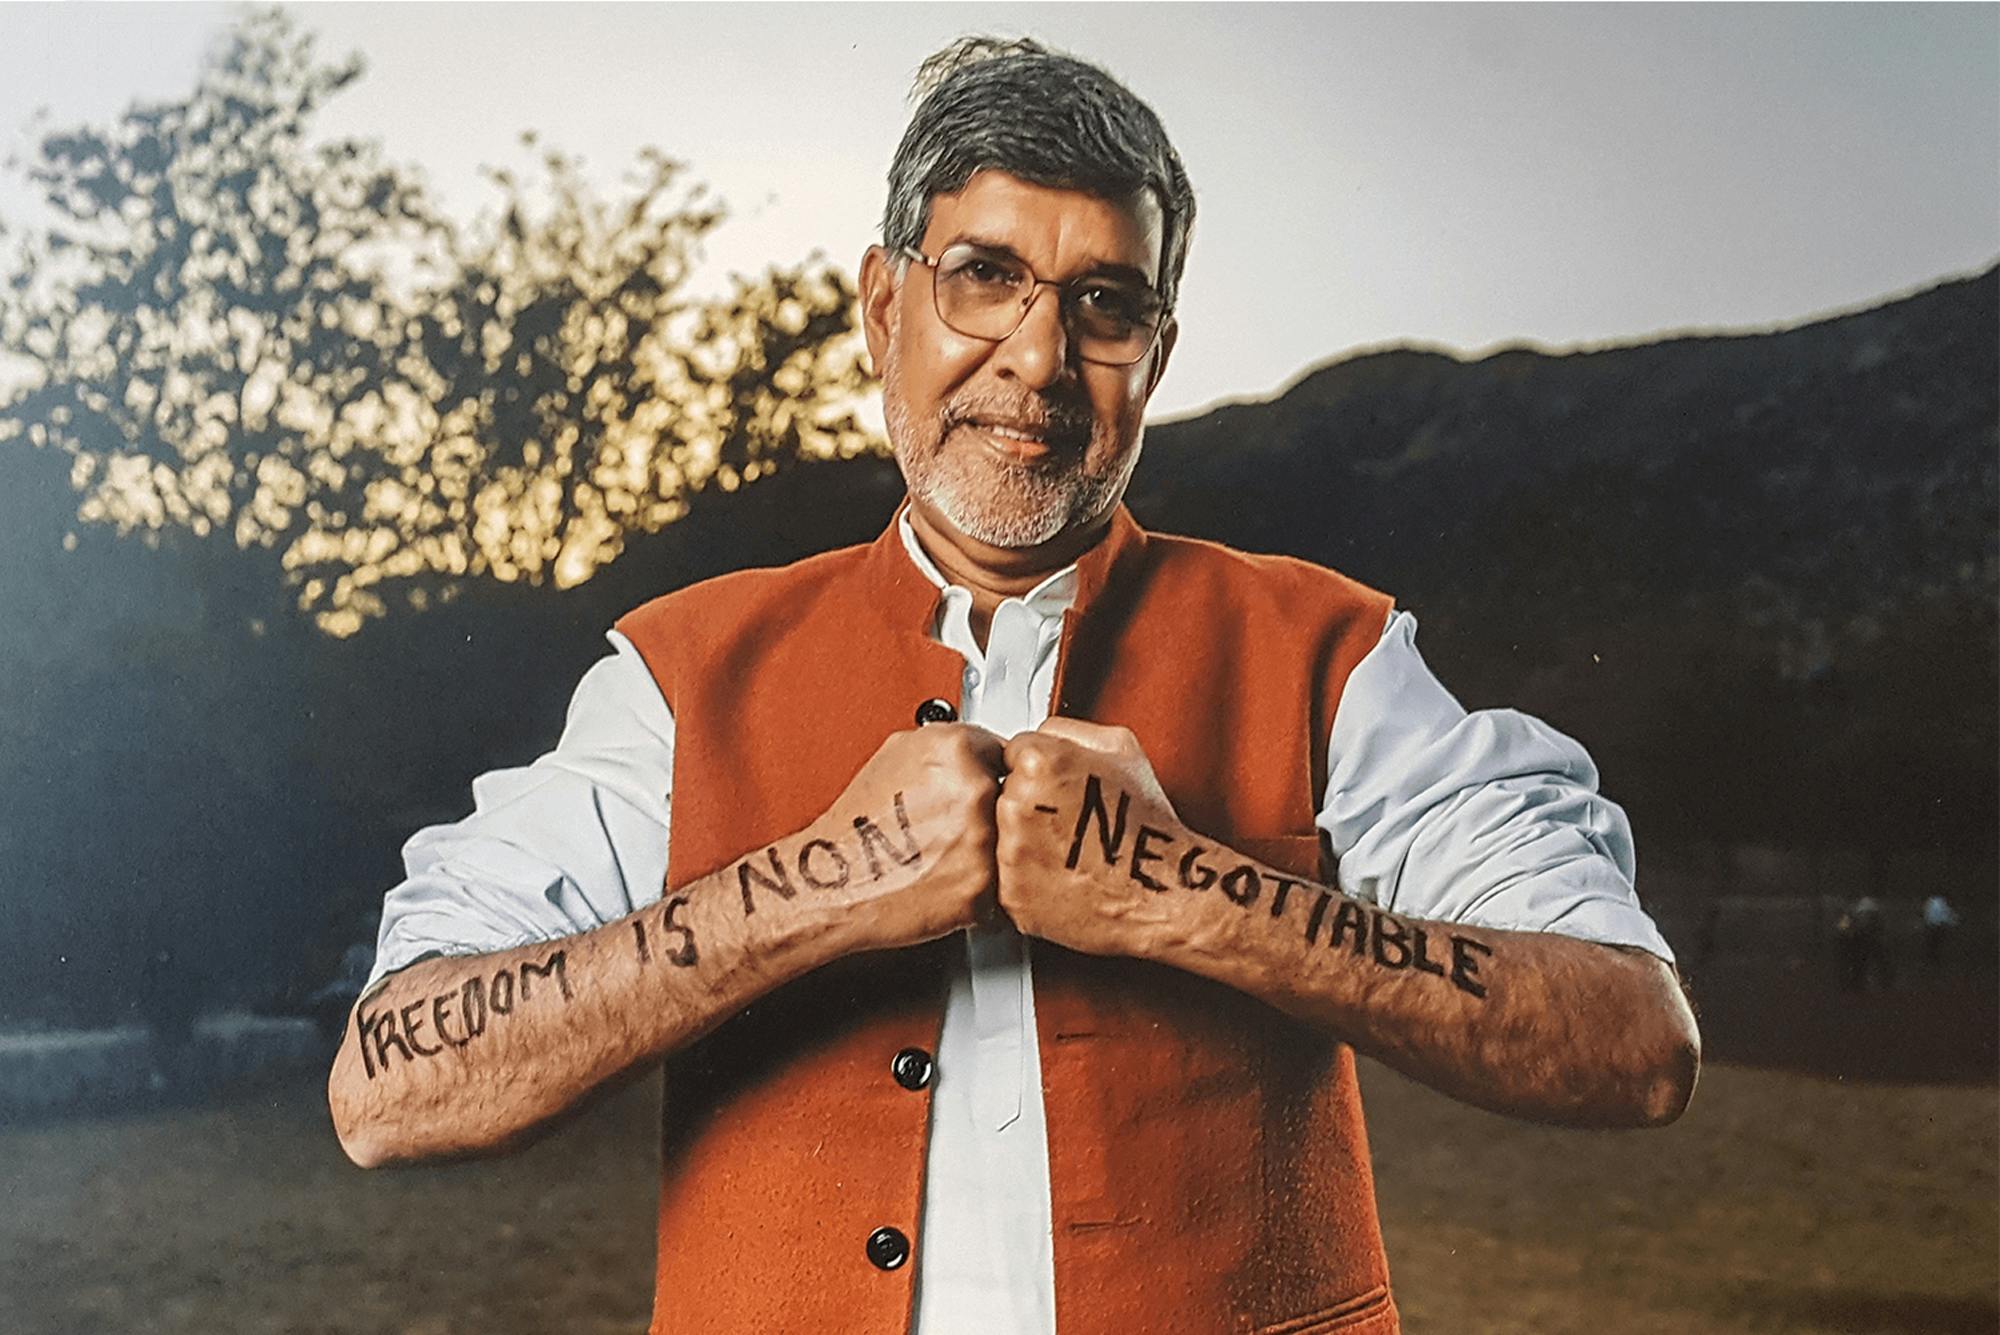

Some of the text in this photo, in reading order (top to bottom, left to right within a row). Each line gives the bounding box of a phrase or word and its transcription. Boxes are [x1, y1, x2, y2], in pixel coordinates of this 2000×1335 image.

[357, 791, 921, 1079] FREEDOM IS NON
